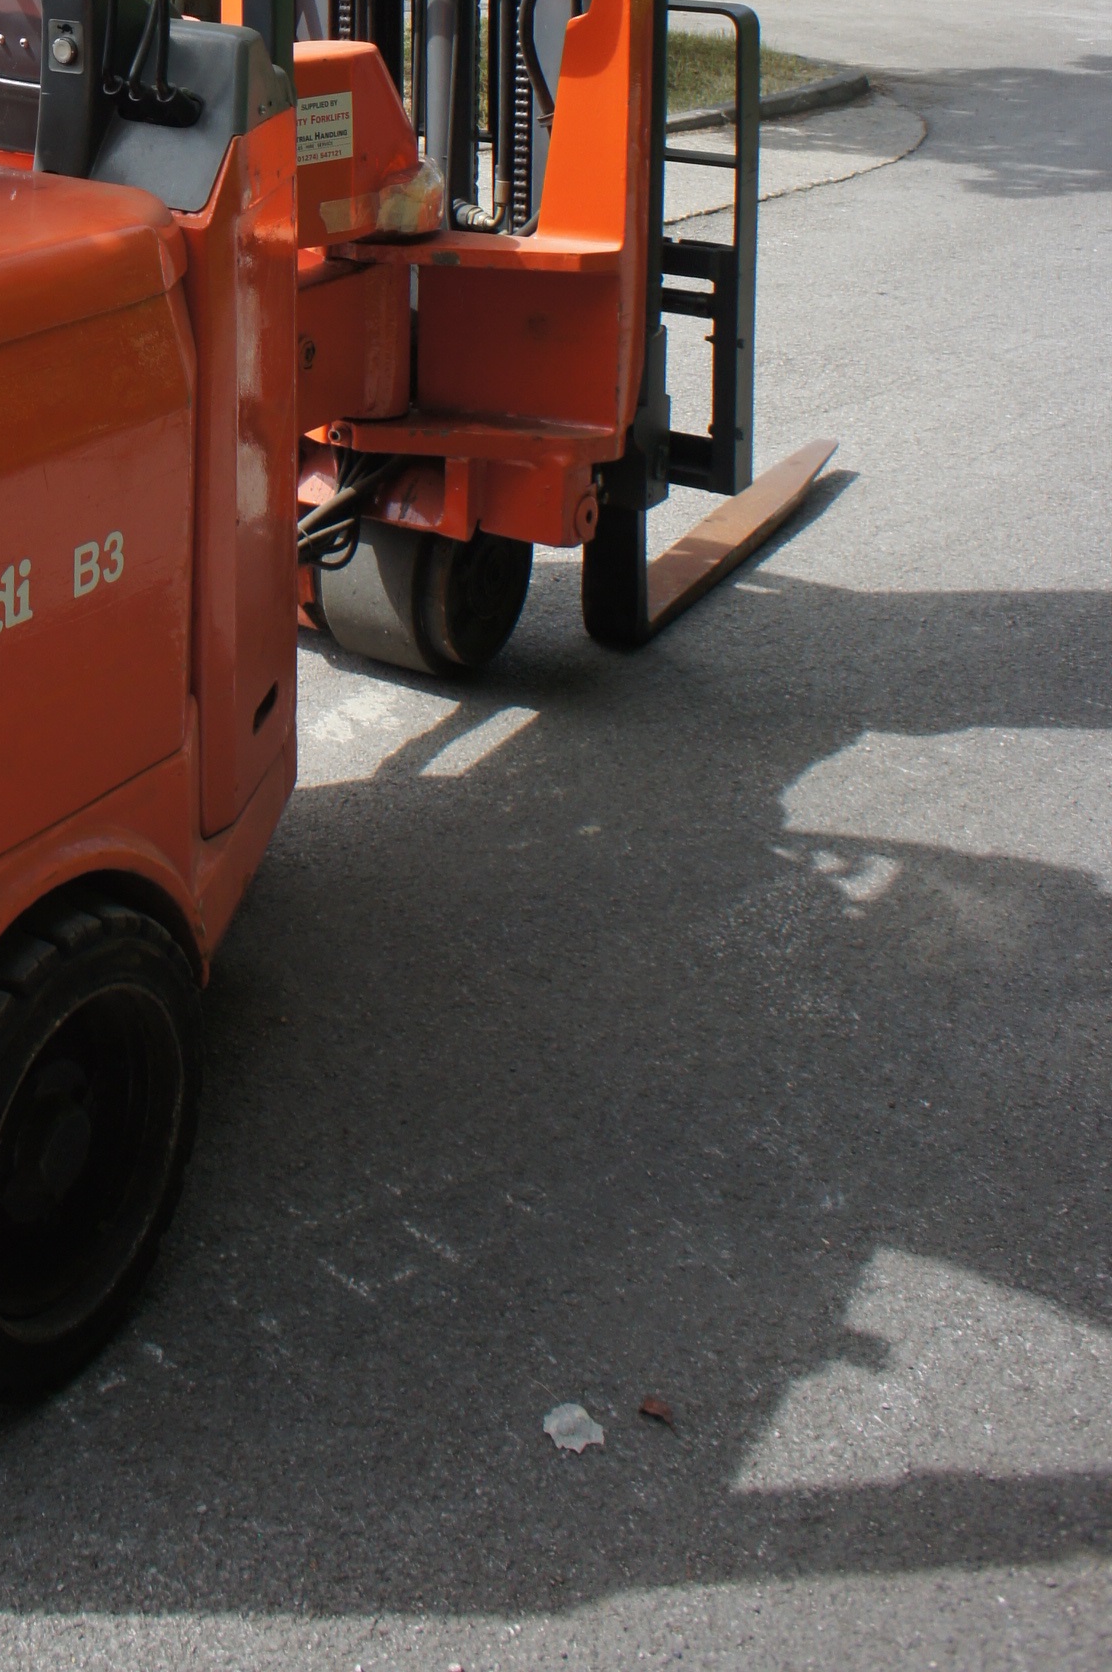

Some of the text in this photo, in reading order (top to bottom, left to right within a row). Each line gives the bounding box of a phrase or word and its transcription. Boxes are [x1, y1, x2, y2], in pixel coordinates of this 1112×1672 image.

[301, 101, 329, 111] SUPPLIED
[311, 112, 349, 124] FORKLIFTS
[315, 130, 347, 140] HANDLING
[320, 150, 342, 158] 547121
[74, 530, 125, 598] B3
